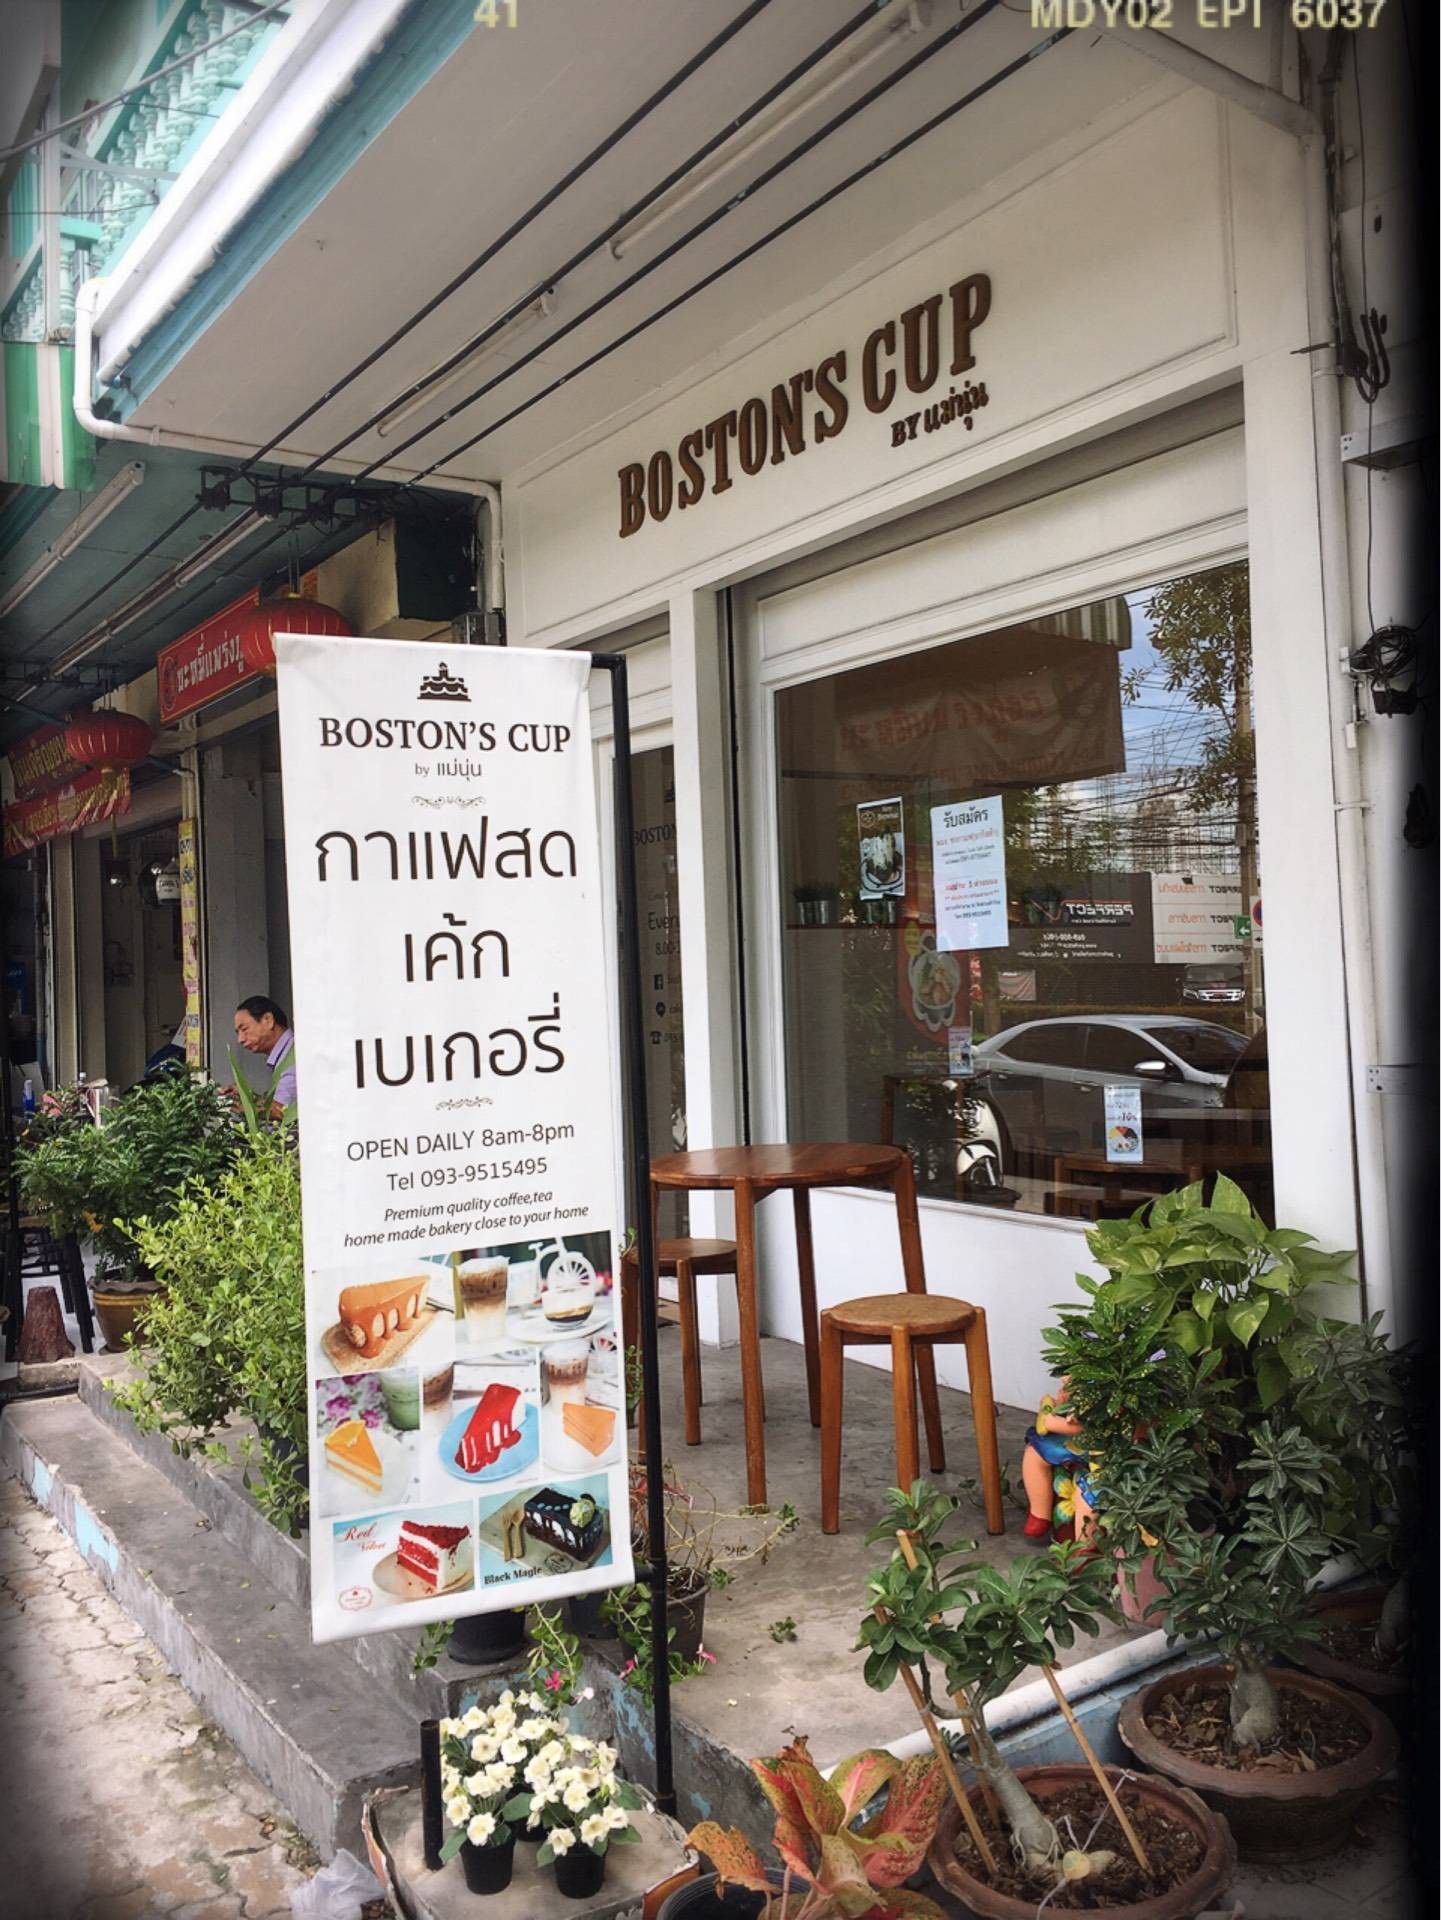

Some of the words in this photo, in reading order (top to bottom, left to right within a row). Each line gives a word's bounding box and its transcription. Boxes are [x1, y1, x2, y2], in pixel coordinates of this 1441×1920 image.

[618, 350, 849, 538] BOSTON'S
[862, 273, 992, 414] CUP
[890, 412, 922, 447] BY
[318, 717, 497, 751] BOSTON'S
[508, 723, 571, 753] CUP
[415, 762, 430, 778] by
[943, 806, 989, 829] รับสมัคร
[315, 816, 577, 882] กาแฟสด
[404, 912, 510, 982] เค้ก
[355, 992, 565, 1088] เบเกอรี่
[347, 1138, 409, 1161] OPEN
[416, 1130, 475, 1154] DAILY
[482, 1122, 575, 1147] 8am-8pm
[387, 1170, 414, 1191] Tel
[420, 1157, 548, 1188] 093-9515495
[344, 1232, 385, 1248] home
[387, 1226, 427, 1244] made
[428, 1218, 473, 1239] bakery
[474, 1214, 507, 1231] close
[508, 1213, 522, 1227] to
[522, 1210, 552, 1229] your
[553, 1205, 589, 1220] home
[384, 1203, 444, 1222] Premium
[447, 1197, 491, 1218] quality
[344, 1522, 377, 1541] Red
[484, 1571, 511, 1585] Black
